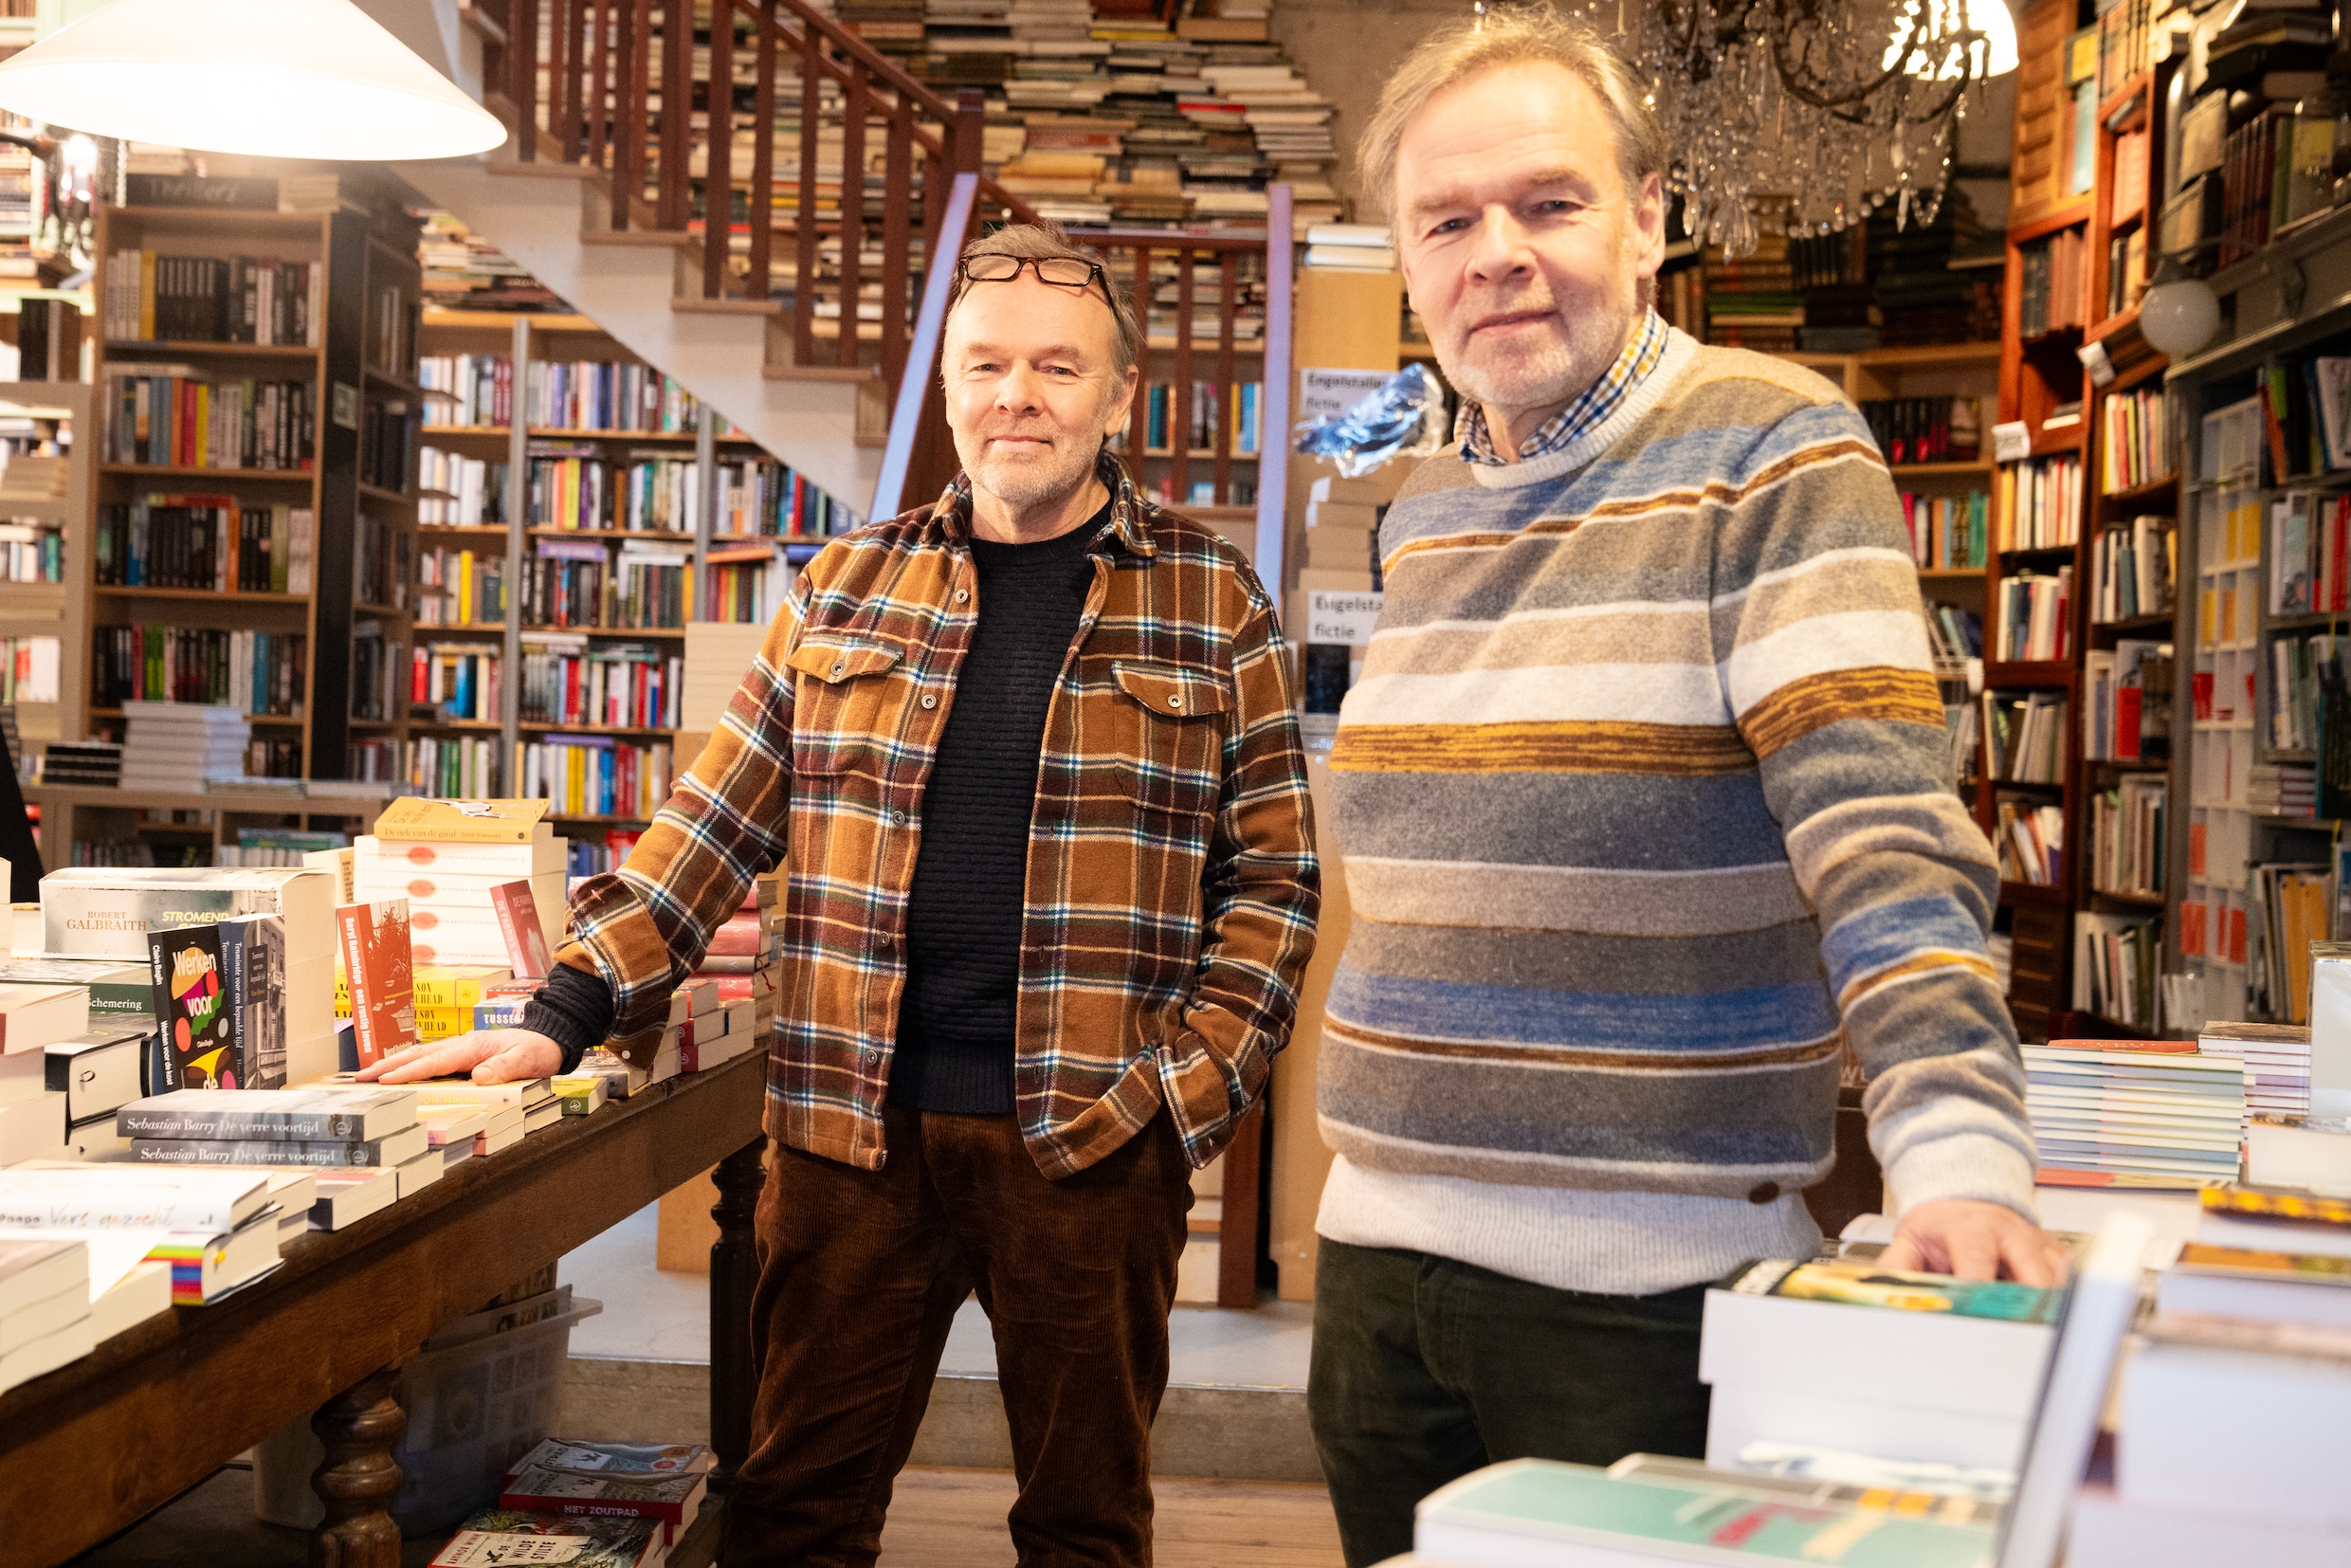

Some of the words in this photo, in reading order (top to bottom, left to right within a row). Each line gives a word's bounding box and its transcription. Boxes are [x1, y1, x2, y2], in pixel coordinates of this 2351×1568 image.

[1315, 594, 1383, 613] Engelsta
[1315, 622, 1356, 639] fictie
[384, 828, 395, 837] De
[396, 830, 410, 838] nek
[428, 830, 437, 839] de
[438, 830, 457, 840] giraf
[496, 900, 505, 913] DE
[87, 911, 127, 920] ROBERT
[162, 911, 229, 922] STROMEND
[66, 920, 147, 931] GALBRAITH
[345, 917, 357, 939] Beryl
[500, 914, 517, 950] FABRIEK
[152, 944, 161, 964] Claire
[347, 939, 362, 985] Bainbridge
[173, 950, 217, 976] Werken
[155, 964, 163, 986] Baglin
[416, 982, 431, 993] SON
[87, 997, 142, 1012] Schemering
[355, 989, 365, 1005] een
[415, 994, 443, 1005] EHEAD
[187, 995, 212, 1017] voor
[233, 1005, 243, 1036] bepaalde
[356, 1005, 371, 1030] rustig
[160, 1020, 170, 1045] Werken
[233, 1036, 243, 1048] tijd
[359, 1030, 373, 1053] leven
[165, 1062, 172, 1070] de
[165, 1071, 173, 1085] kost
[203, 1073, 219, 1089] de
[418, 1096, 439, 1104] ION
[127, 1118, 181, 1130] Sebastian
[183, 1119, 217, 1133] Barry
[220, 1120, 237, 1132] De
[240, 1122, 270, 1133] verre
[272, 1121, 319, 1137] voortijd
[140, 1148, 195, 1160] Sebastian
[198, 1149, 233, 1163] Barry
[235, 1149, 252, 1161] De
[255, 1152, 285, 1162] verre
[288, 1150, 335, 1165] voortijd
[564, 1504, 586, 1514] HET
[589, 1505, 639, 1517] ZOUTPAD
[509, 1541, 536, 1558] WILDE
[530, 1541, 556, 1559] STILTE
